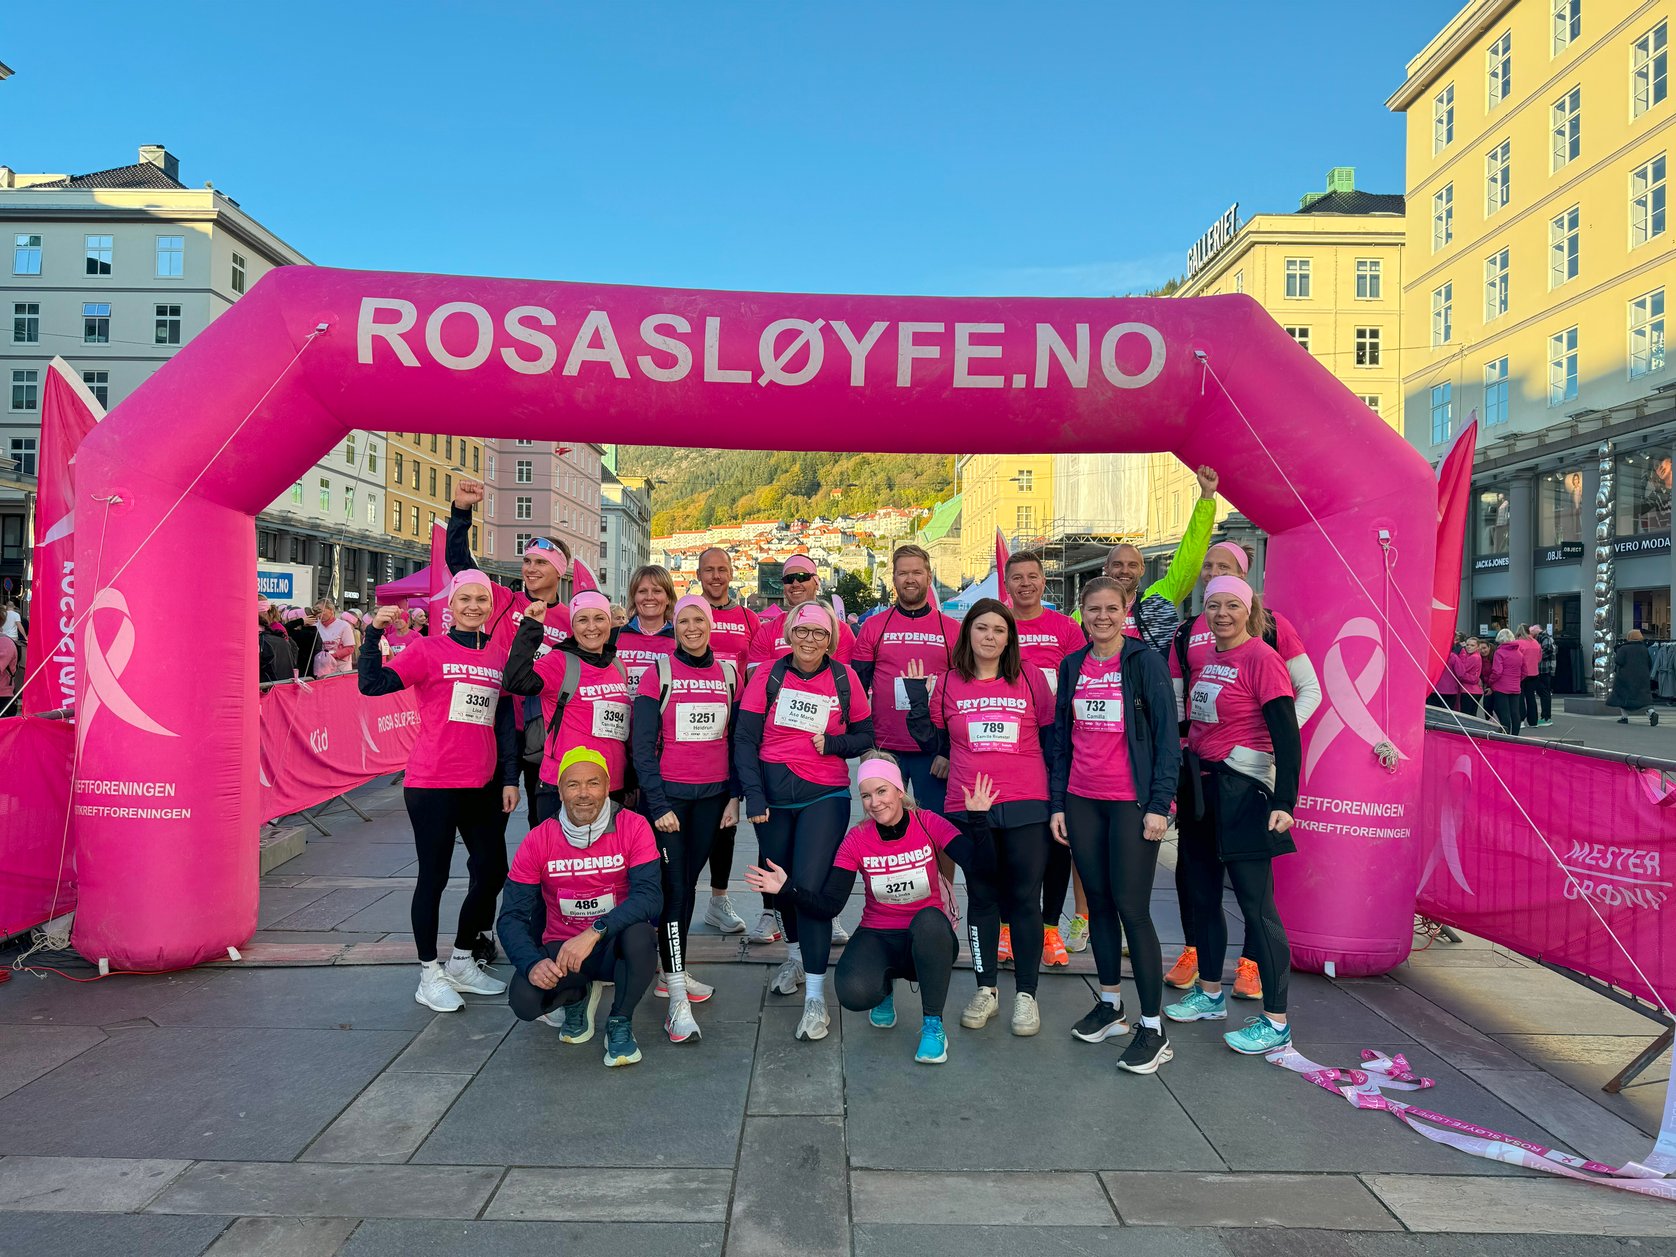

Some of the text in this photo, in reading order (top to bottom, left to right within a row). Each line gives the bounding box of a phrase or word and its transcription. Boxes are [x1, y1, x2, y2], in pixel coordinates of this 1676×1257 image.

[1187, 202, 1239, 279] GALLERIET
[357, 296, 1166, 388] ROSASLØYFE.NO
[1614, 538, 1671, 553] VERO MODA
[883, 632, 945, 643] FRYDENBØ
[465, 694, 490, 707] 3330
[789, 699, 818, 714] 3365
[956, 697, 1027, 710] FRYDENBØ
[1086, 700, 1106, 712] 732
[603, 710, 624, 723] 3394
[689, 712, 716, 723] 3251
[982, 722, 1005, 733] 789
[309, 726, 329, 754] Kid
[1296, 795, 1405, 817] EFTFORENINGEN
[547, 852, 624, 872] FRYDENBØ
[862, 843, 932, 868] FRYDENBØ
[1564, 839, 1661, 877] MESTER
[885, 880, 914, 894] 3271
[574, 898, 598, 910] 486
[670, 921, 683, 972] FRYDENBØ
[971, 925, 984, 973] FRYDENBØ
[1503, 1137, 1542, 1153] ROSA
